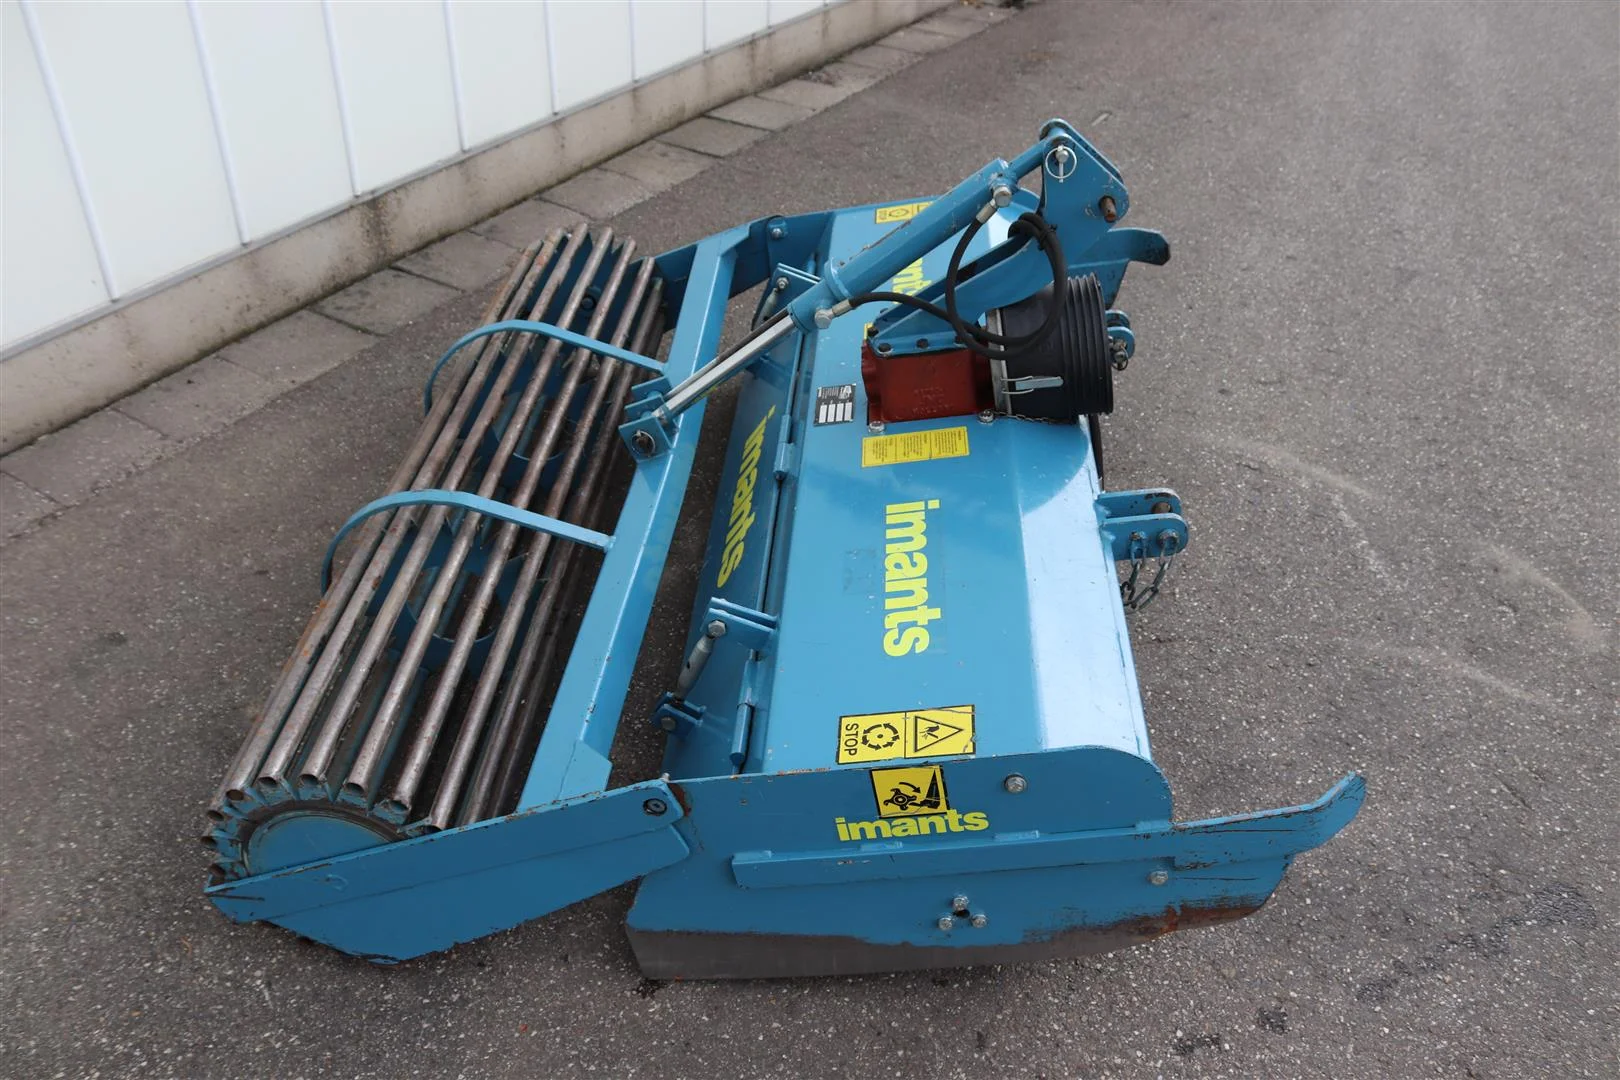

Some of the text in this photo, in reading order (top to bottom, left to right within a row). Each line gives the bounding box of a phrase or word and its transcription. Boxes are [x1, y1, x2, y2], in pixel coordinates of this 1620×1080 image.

[717, 406, 776, 588] imants
[884, 499, 940, 657] imants
[844, 723, 860, 756] STOP
[835, 809, 989, 841] imants
